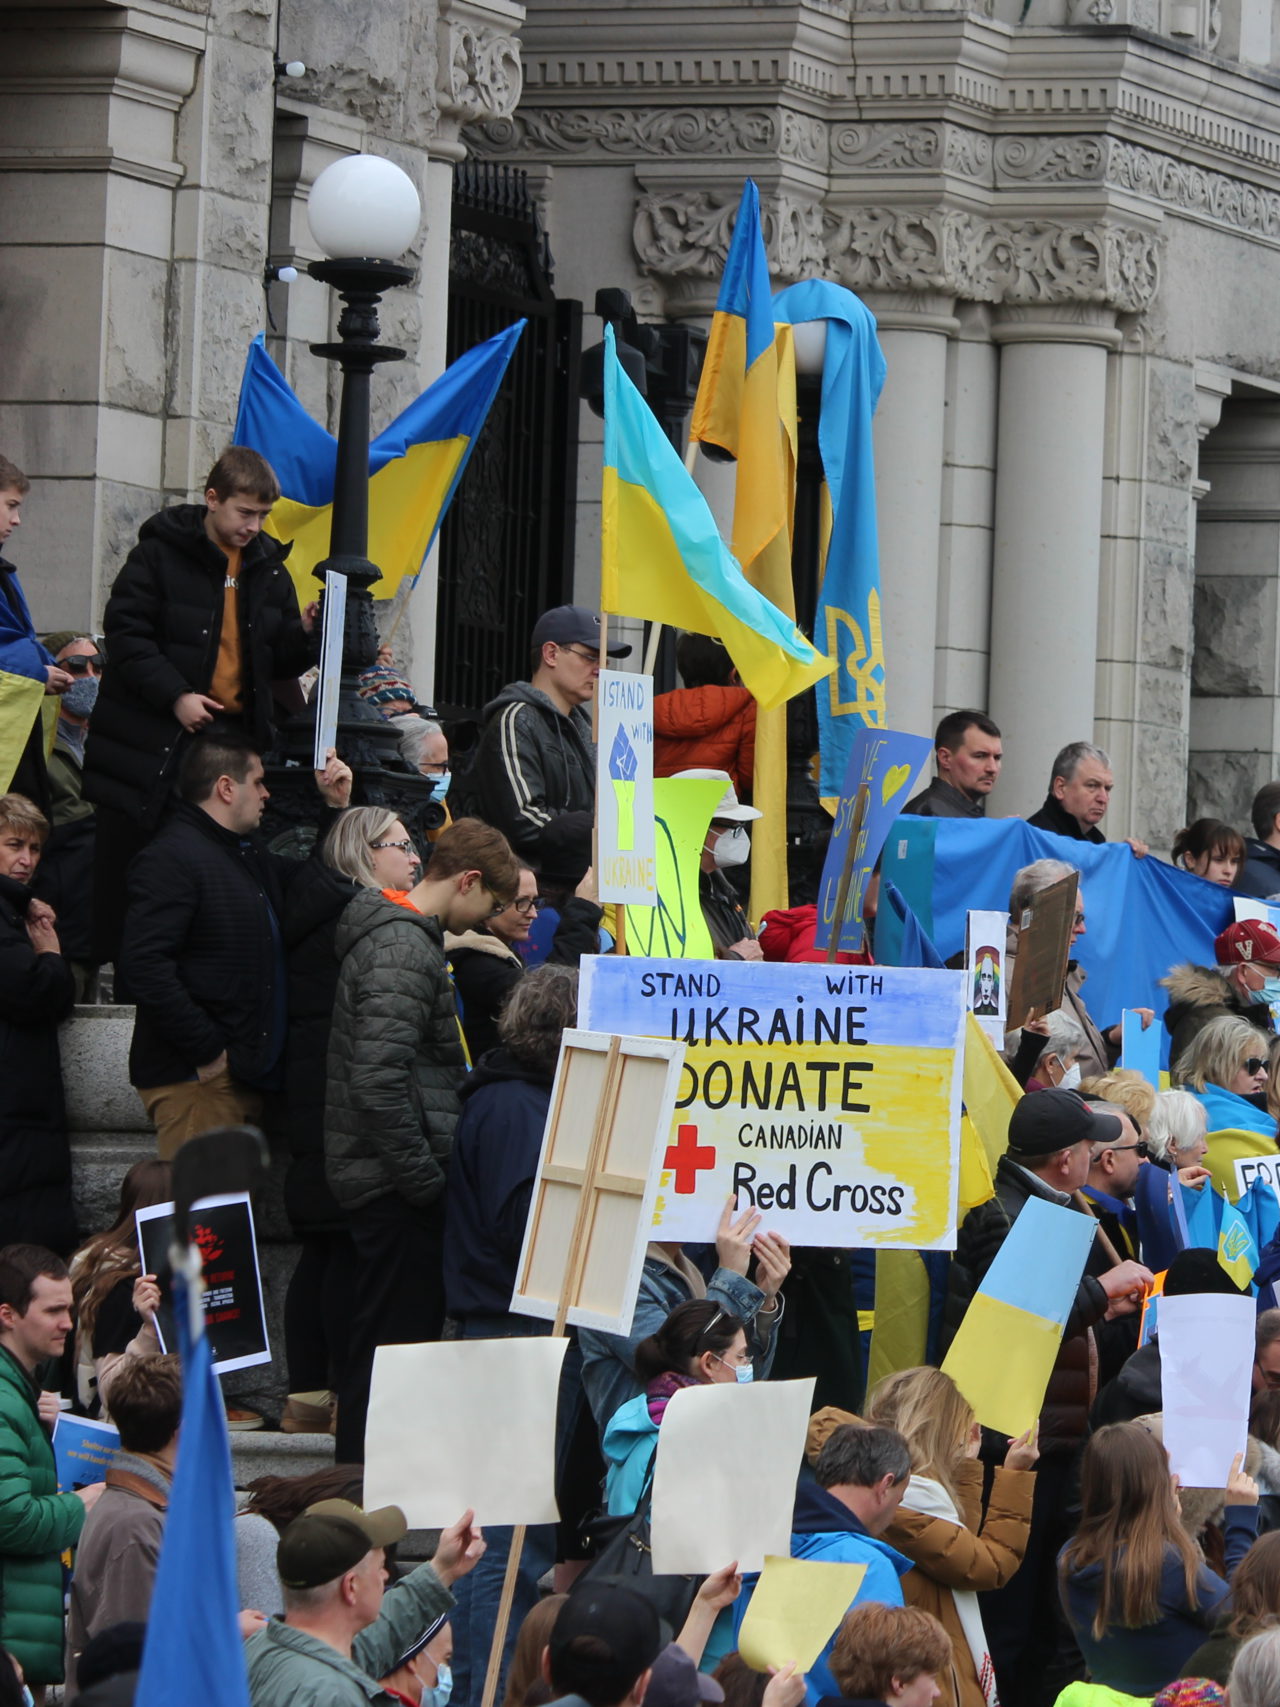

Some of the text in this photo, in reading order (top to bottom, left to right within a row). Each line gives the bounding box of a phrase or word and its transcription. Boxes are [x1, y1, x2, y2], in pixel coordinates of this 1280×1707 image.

[608, 681, 645, 711] STAND
[631, 722, 653, 744] WITH
[603, 856, 654, 892] UKRAINE
[1235, 940, 1253, 960] V
[641, 971, 883, 997] STAND WITH
[671, 995, 868, 1047] UKRAINE
[675, 1060, 873, 1113] DONATE
[738, 1119, 842, 1150] CANADIAN
[733, 1161, 904, 1216] Red Cross
